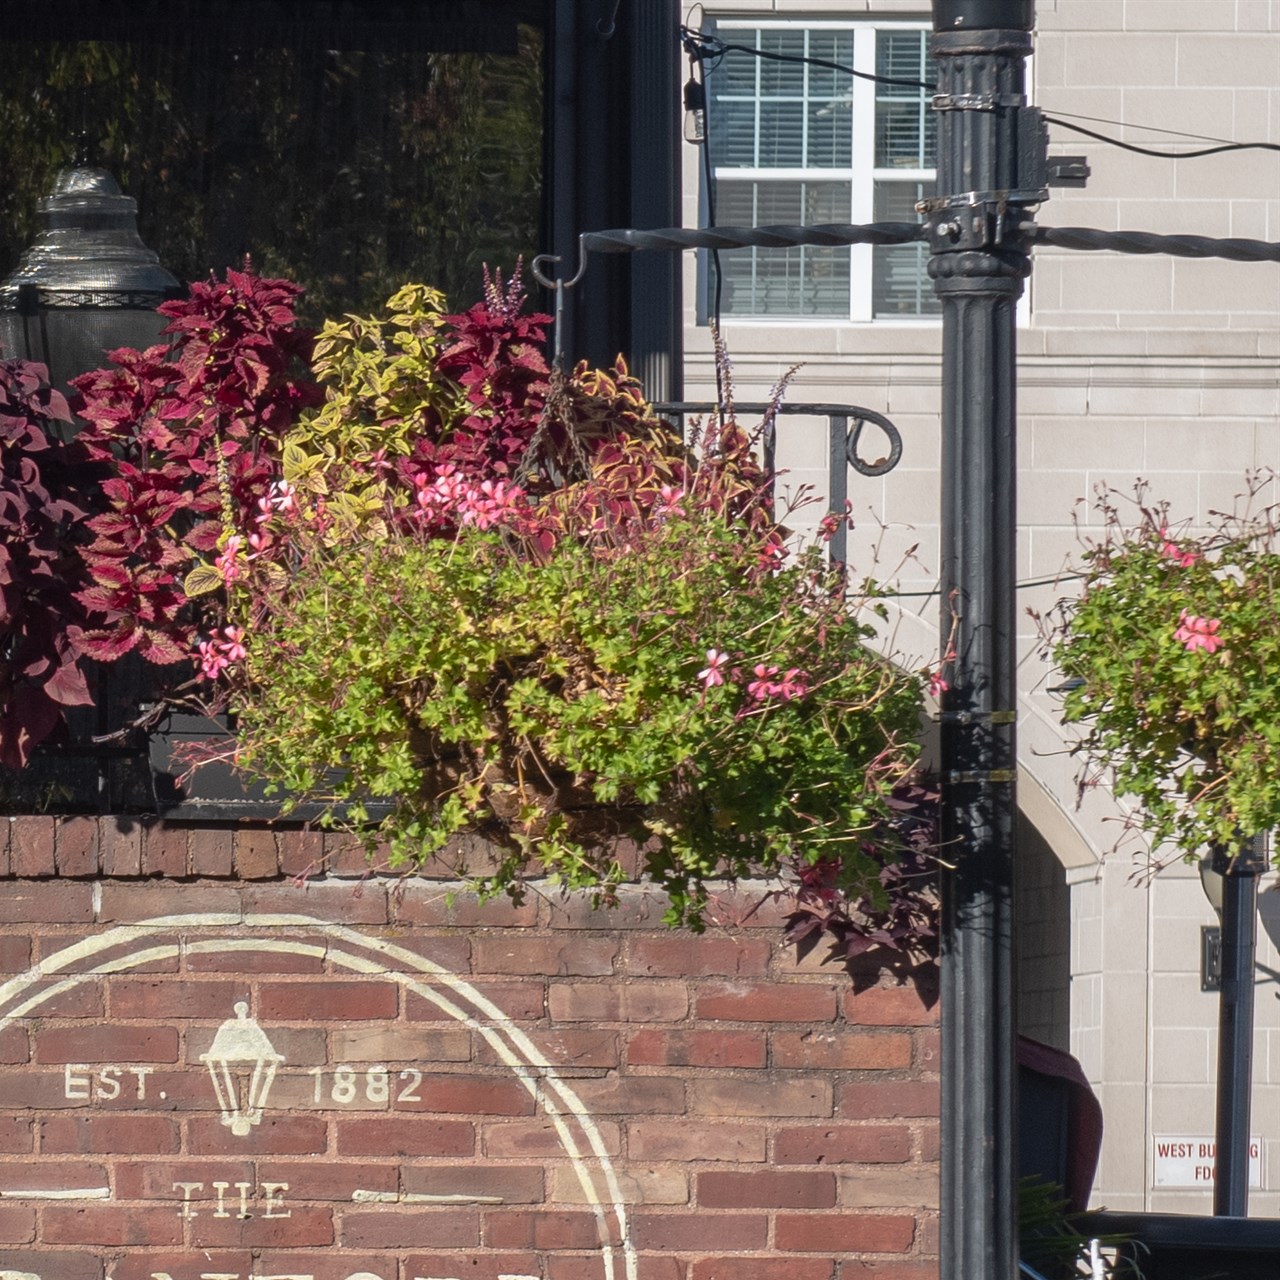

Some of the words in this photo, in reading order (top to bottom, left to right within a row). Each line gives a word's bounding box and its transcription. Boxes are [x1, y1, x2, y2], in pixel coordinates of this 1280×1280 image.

[63, 1063, 168, 1101] EST.
[307, 1065, 424, 1104] 1882
[1157, 1143, 1194, 1158] WEST
[171, 1181, 292, 1220] THE
